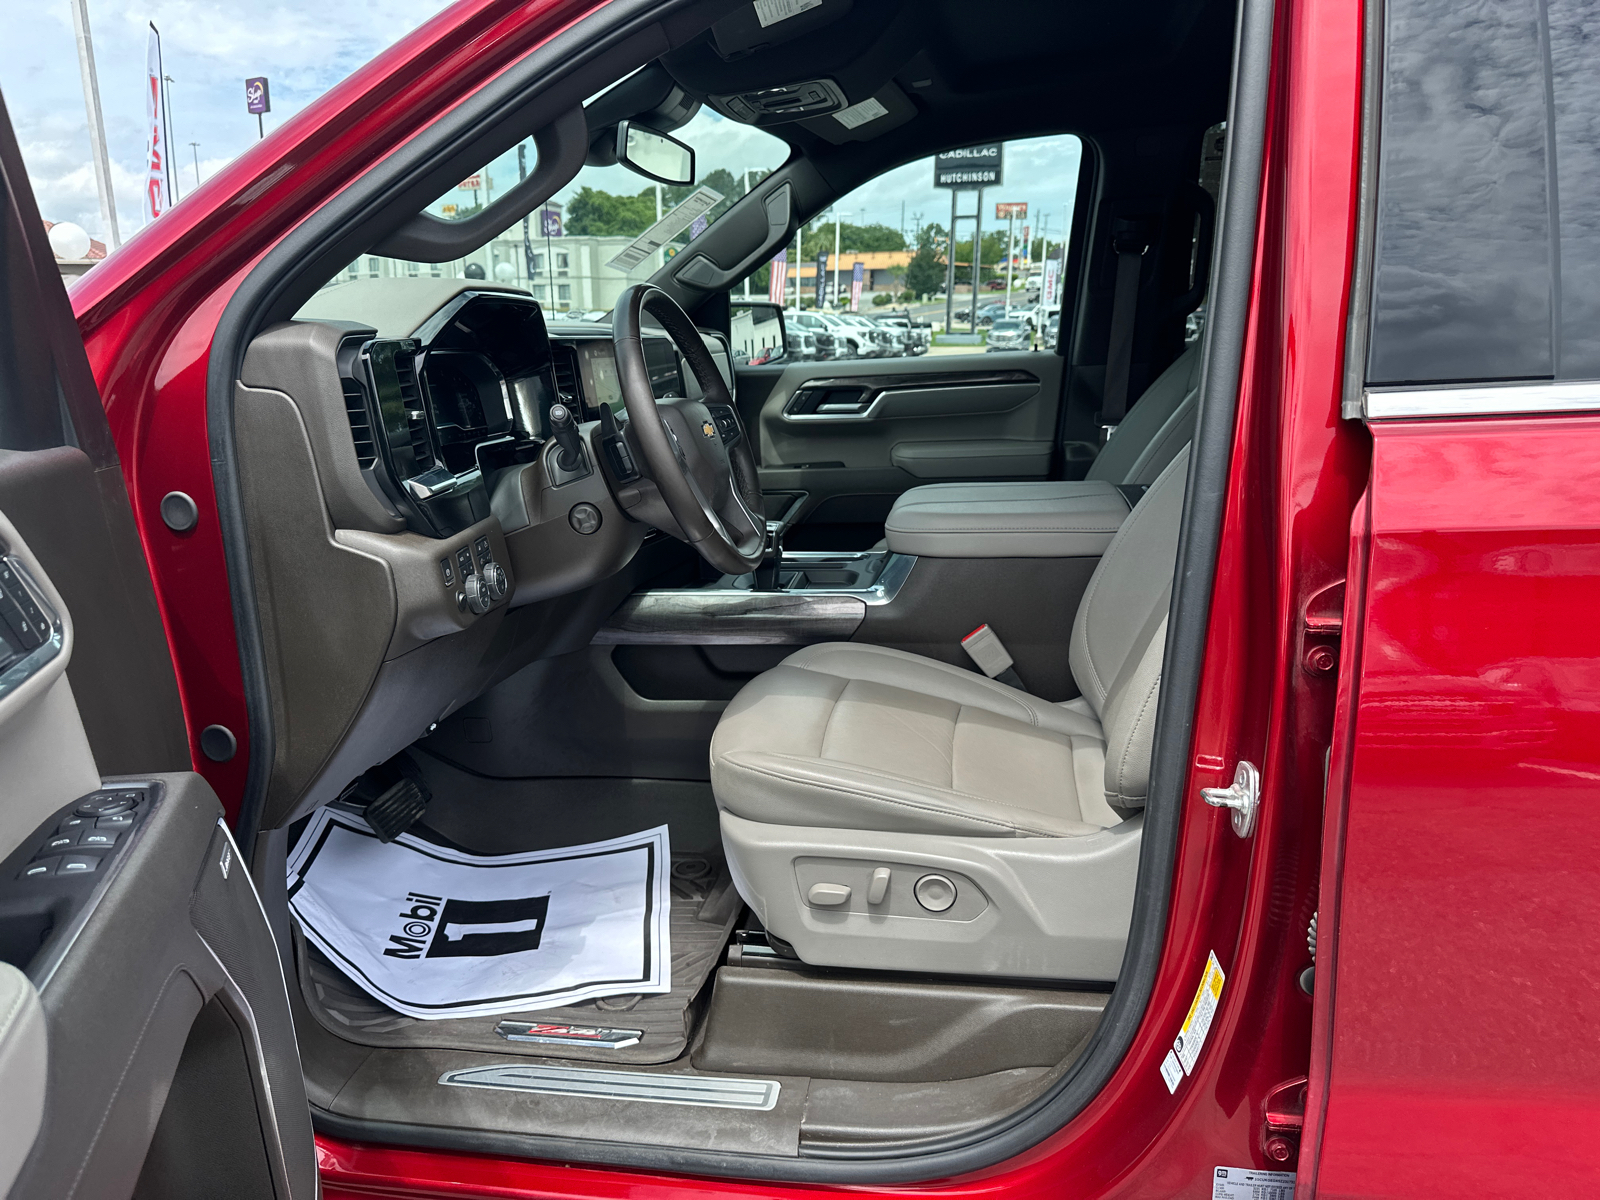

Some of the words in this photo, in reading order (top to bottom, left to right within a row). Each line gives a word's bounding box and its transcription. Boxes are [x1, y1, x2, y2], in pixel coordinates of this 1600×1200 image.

[938, 147, 998, 159] CADILLAC
[940, 170, 996, 183] HUTCHINSON
[1046, 269, 1054, 300] GMC
[382, 891, 443, 960] Mobil
[444, 918, 538, 942] 1
